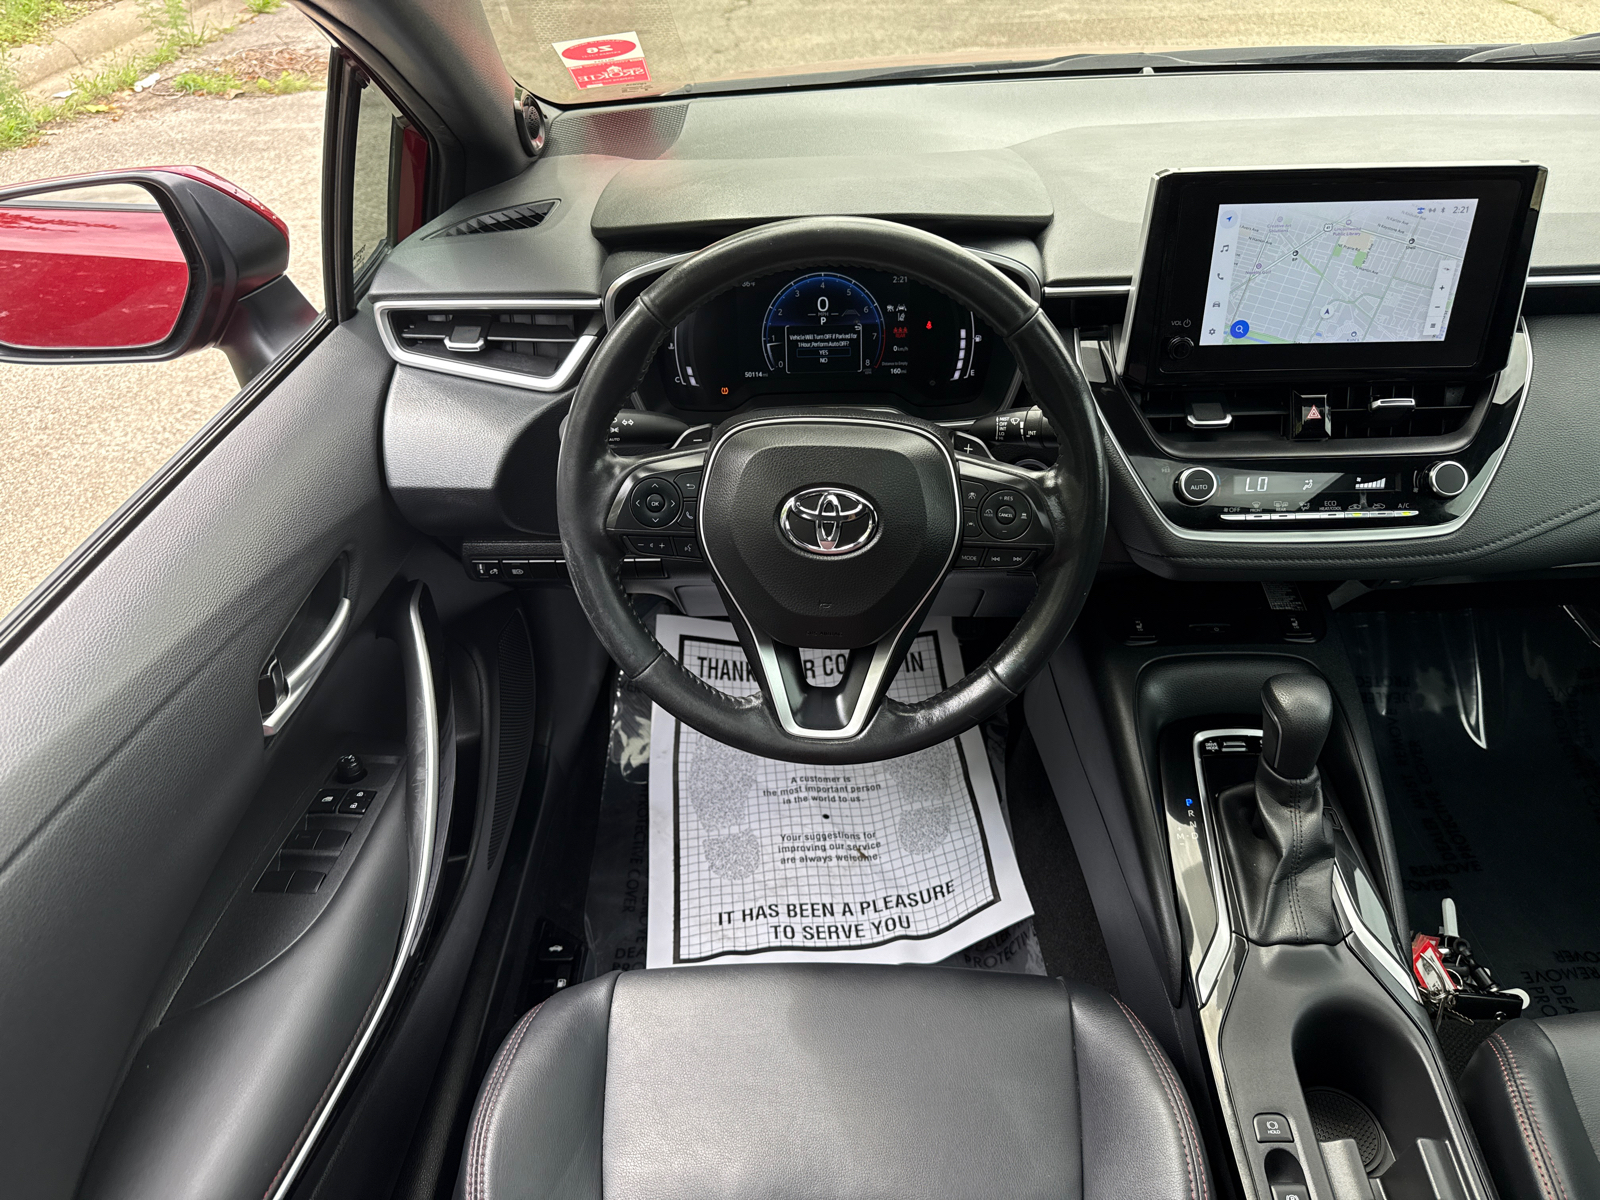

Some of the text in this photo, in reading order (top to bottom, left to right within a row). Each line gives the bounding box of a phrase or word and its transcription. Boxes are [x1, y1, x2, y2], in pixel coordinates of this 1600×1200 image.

[817, 297, 828, 312] 0
[697, 651, 924, 682] THANK IN
[780, 786, 802, 795] most
[805, 785, 848, 793] important
[851, 784, 881, 793] person
[1186, 798, 1193, 806] P
[804, 832, 860, 841] suggestions
[778, 844, 826, 853] improving
[847, 841, 881, 851] service
[780, 856, 796, 864] are
[799, 855, 833, 864] always
[718, 879, 956, 925] IT HAS BEEN A PLEASURE
[769, 915, 911, 940] TO SERVE YOU
